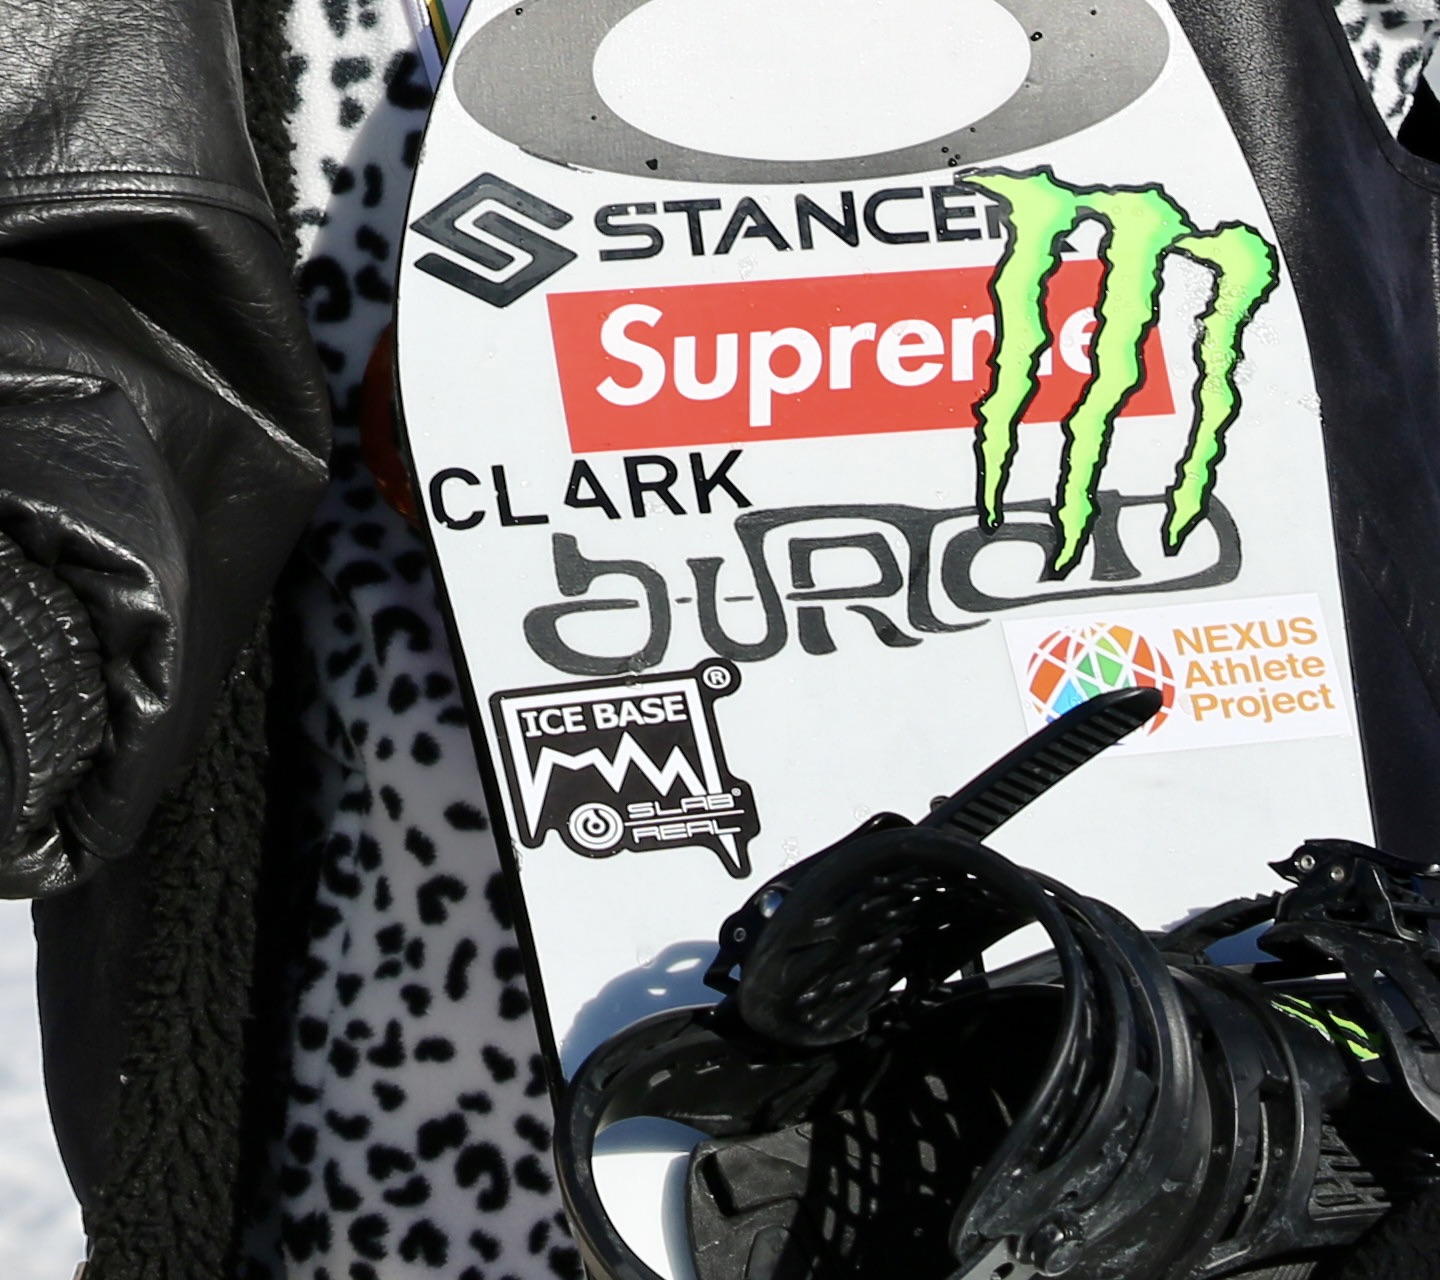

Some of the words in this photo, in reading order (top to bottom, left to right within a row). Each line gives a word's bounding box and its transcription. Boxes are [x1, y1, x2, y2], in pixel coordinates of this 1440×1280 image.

[594, 185, 984, 262] STANCE
[429, 450, 754, 532] CLARK
[1172, 616, 1319, 656] NEXUS
[1184, 653, 1327, 690] Athlete
[520, 706, 588, 738] ICE
[592, 694, 688, 731] BASE
[1189, 683, 1337, 724] Project
[626, 792, 736, 820] SLAB
[631, 820, 742, 844] REAL
